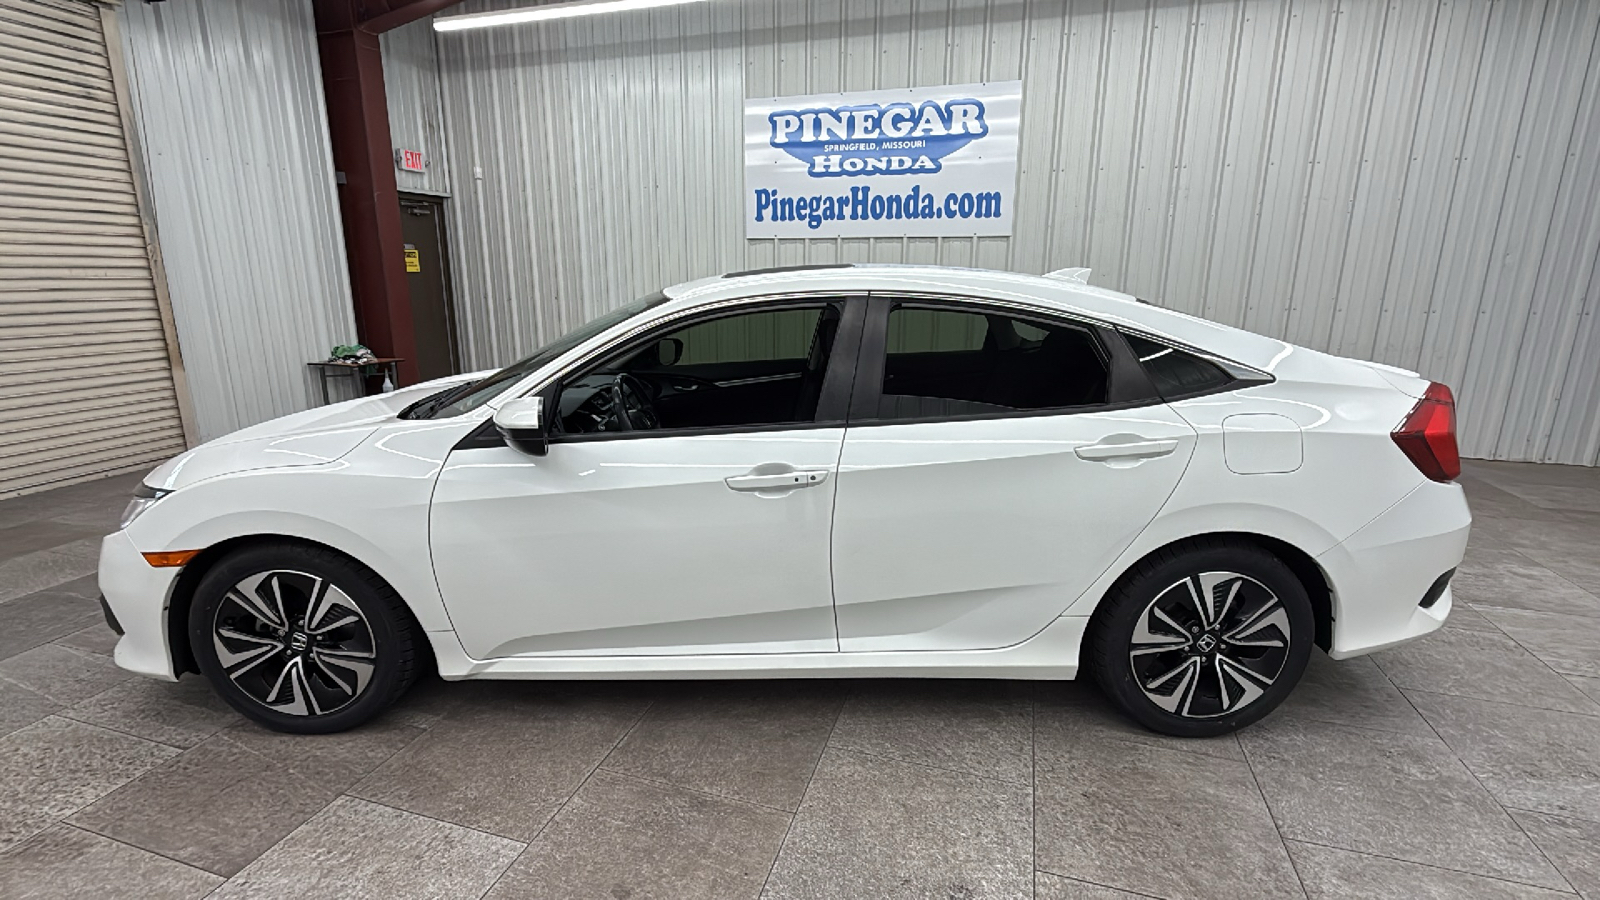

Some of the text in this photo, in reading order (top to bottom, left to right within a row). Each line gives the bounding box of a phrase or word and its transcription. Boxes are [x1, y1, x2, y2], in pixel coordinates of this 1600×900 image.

[772, 104, 985, 143] PINEGAR
[823, 139, 926, 153] SPRINGFIELD, MISSOURI
[404, 150, 422, 170] EXIT
[811, 154, 938, 173] HONDA
[754, 185, 1002, 229] PinegarHonda.com
